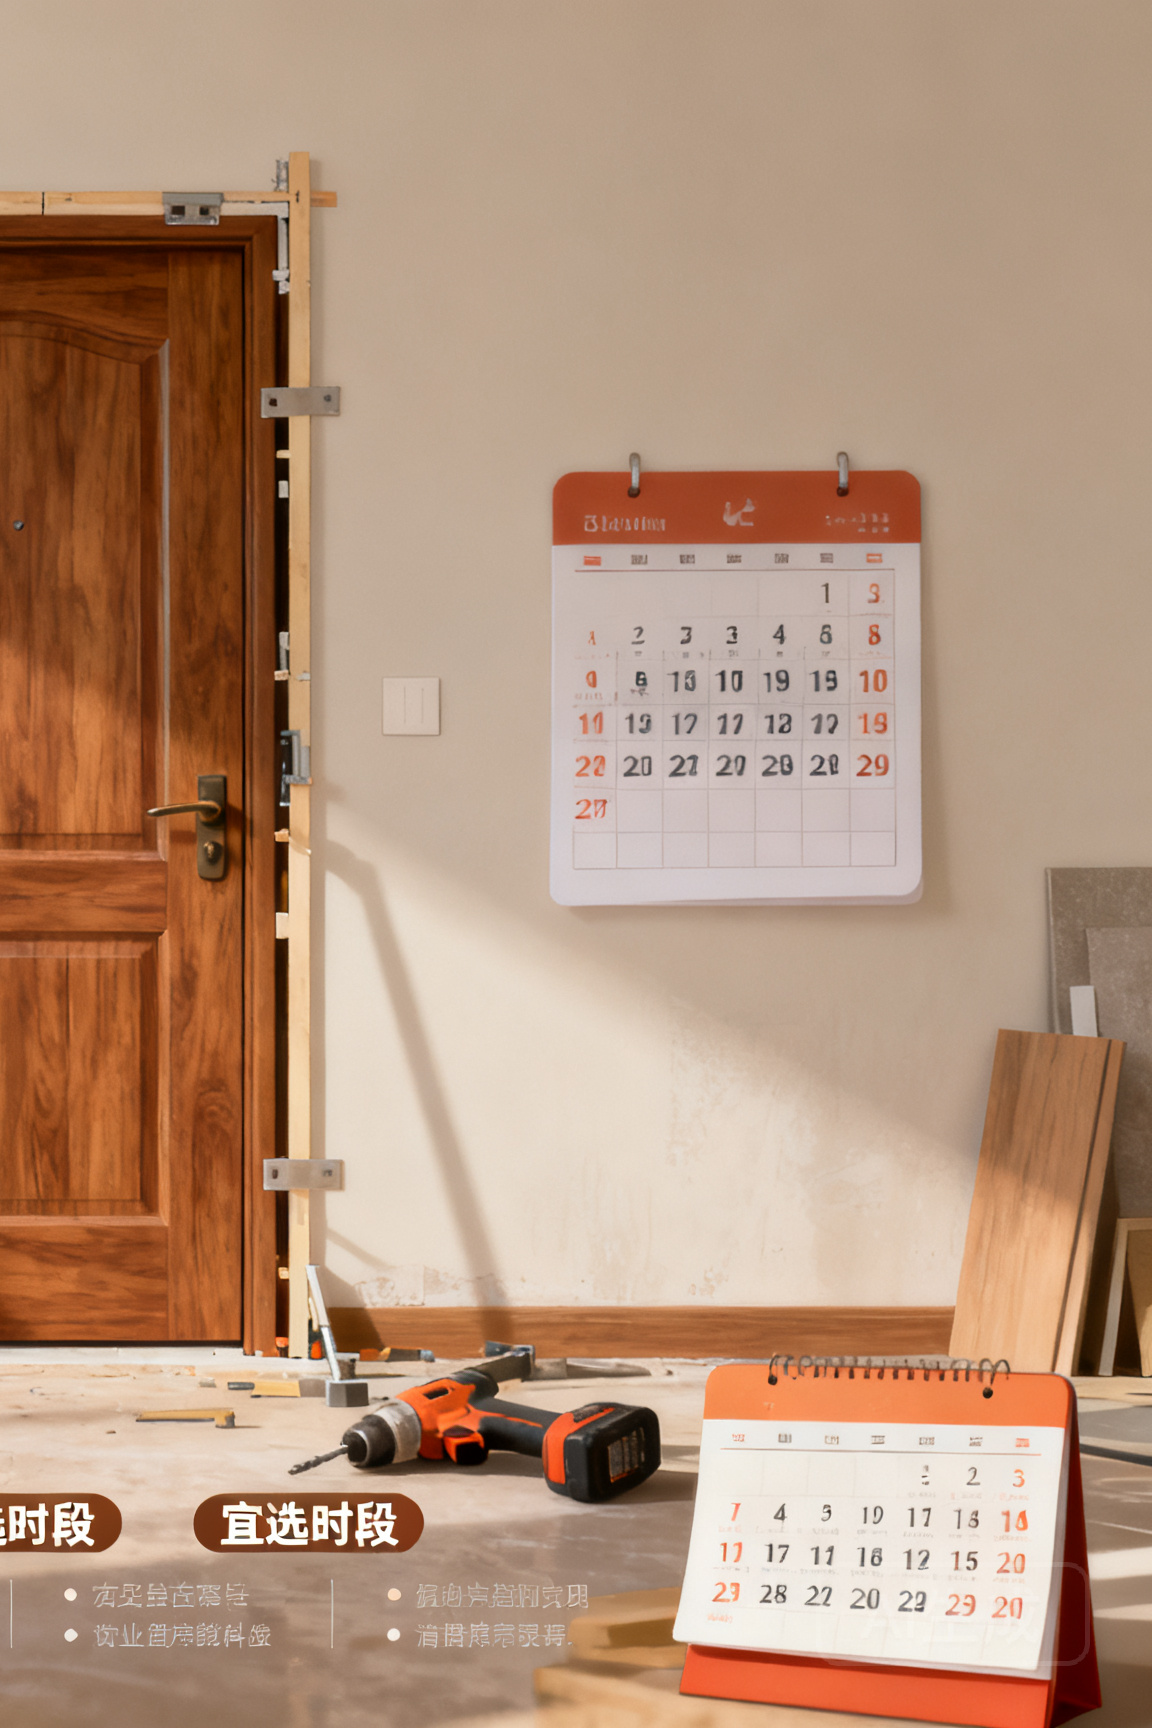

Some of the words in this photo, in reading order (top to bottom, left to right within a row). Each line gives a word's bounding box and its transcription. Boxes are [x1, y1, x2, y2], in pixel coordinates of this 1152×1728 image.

[821, 582, 830, 604] 1
[772, 623, 786, 646] 4
[868, 623, 882, 646] 8
[763, 669, 790, 693] 19
[859, 668, 888, 693] 10
[856, 753, 890, 777] 29
[966, 1466, 981, 1486] 2
[1012, 1468, 1026, 1488] 3
[773, 1502, 787, 1522] 4
[907, 1507, 932, 1528] 17
[766, 1543, 790, 1564] 17
[952, 1550, 979, 1571] 15
[996, 1551, 1026, 1574] 20
[759, 1584, 788, 1604] 28
[849, 1587, 881, 1610] 20
